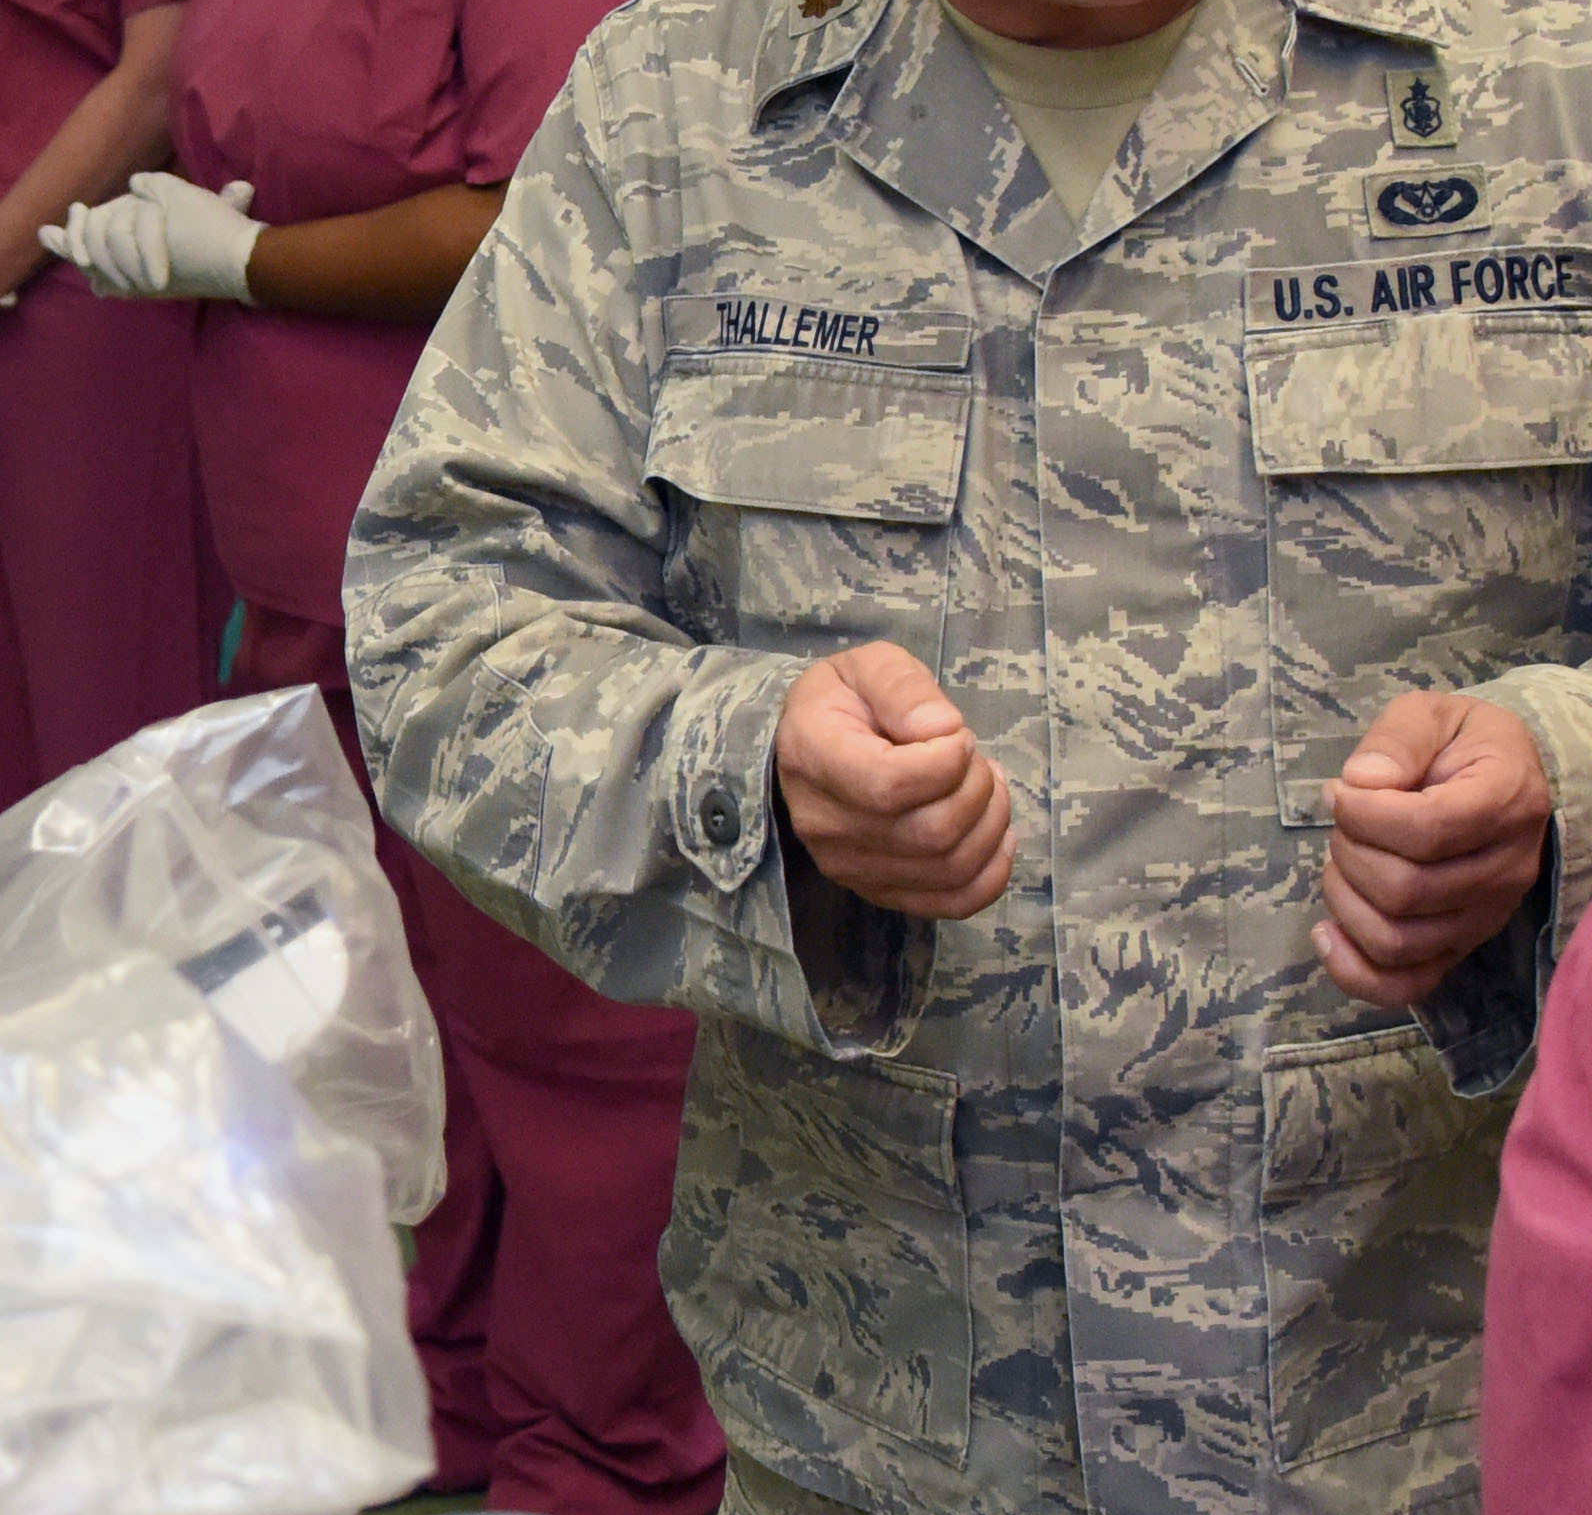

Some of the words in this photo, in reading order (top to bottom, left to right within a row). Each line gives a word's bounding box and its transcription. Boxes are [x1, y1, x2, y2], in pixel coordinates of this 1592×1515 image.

[1273, 273, 1355, 322] U.S.
[1370, 264, 1438, 313] AIR
[1449, 253, 1577, 306] FORCE
[716, 299, 881, 357] THALLEMER
